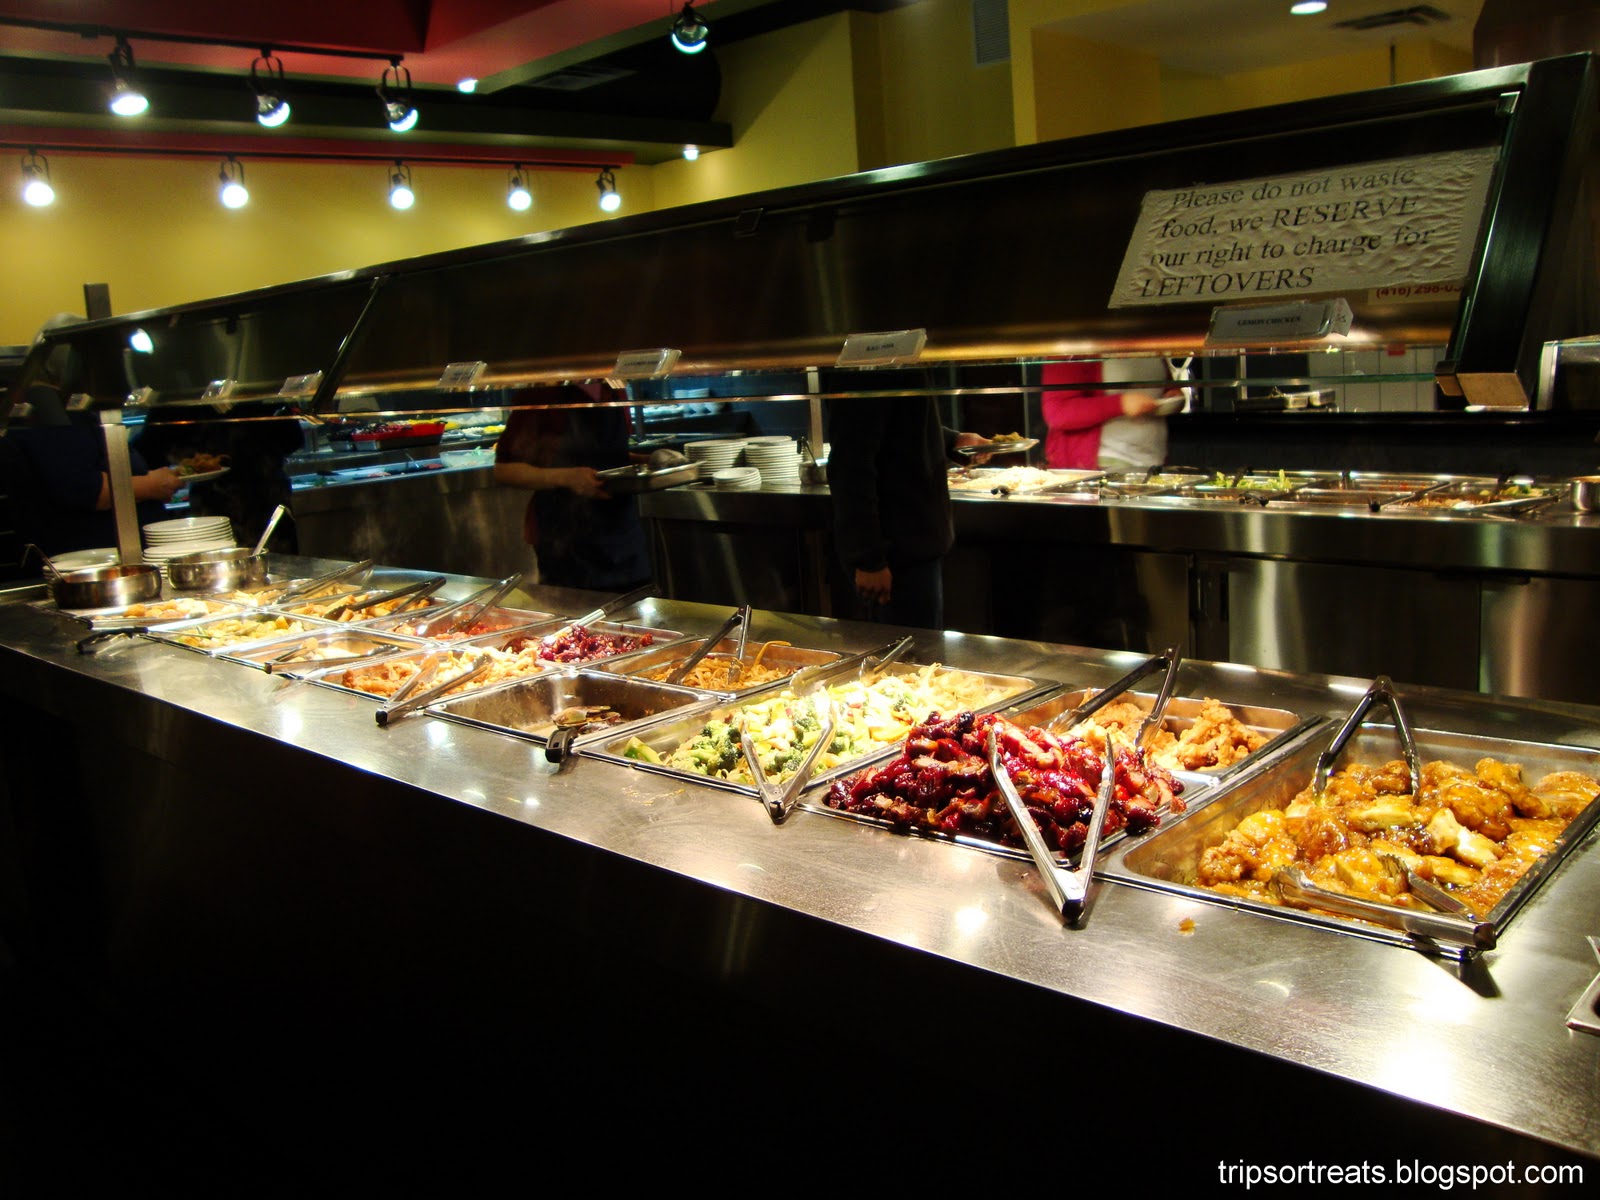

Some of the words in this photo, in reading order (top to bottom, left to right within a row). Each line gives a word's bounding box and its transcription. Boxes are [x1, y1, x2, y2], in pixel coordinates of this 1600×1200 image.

[1173, 189, 1244, 209] Please
[1252, 182, 1282, 201] do
[1290, 179, 1329, 198] not
[1340, 169, 1416, 191] waste
[1160, 216, 1219, 239] food,
[1229, 214, 1263, 231] we
[1272, 195, 1421, 229] RESERVE
[1150, 252, 1190, 267] our
[1195, 239, 1254, 269] right
[1260, 241, 1284, 259] to
[1293, 234, 1381, 258] charge
[1393, 226, 1436, 246] for
[1141, 267, 1315, 298] LEFTOVERS
[1266, 316, 1302, 325] CHICKEN
